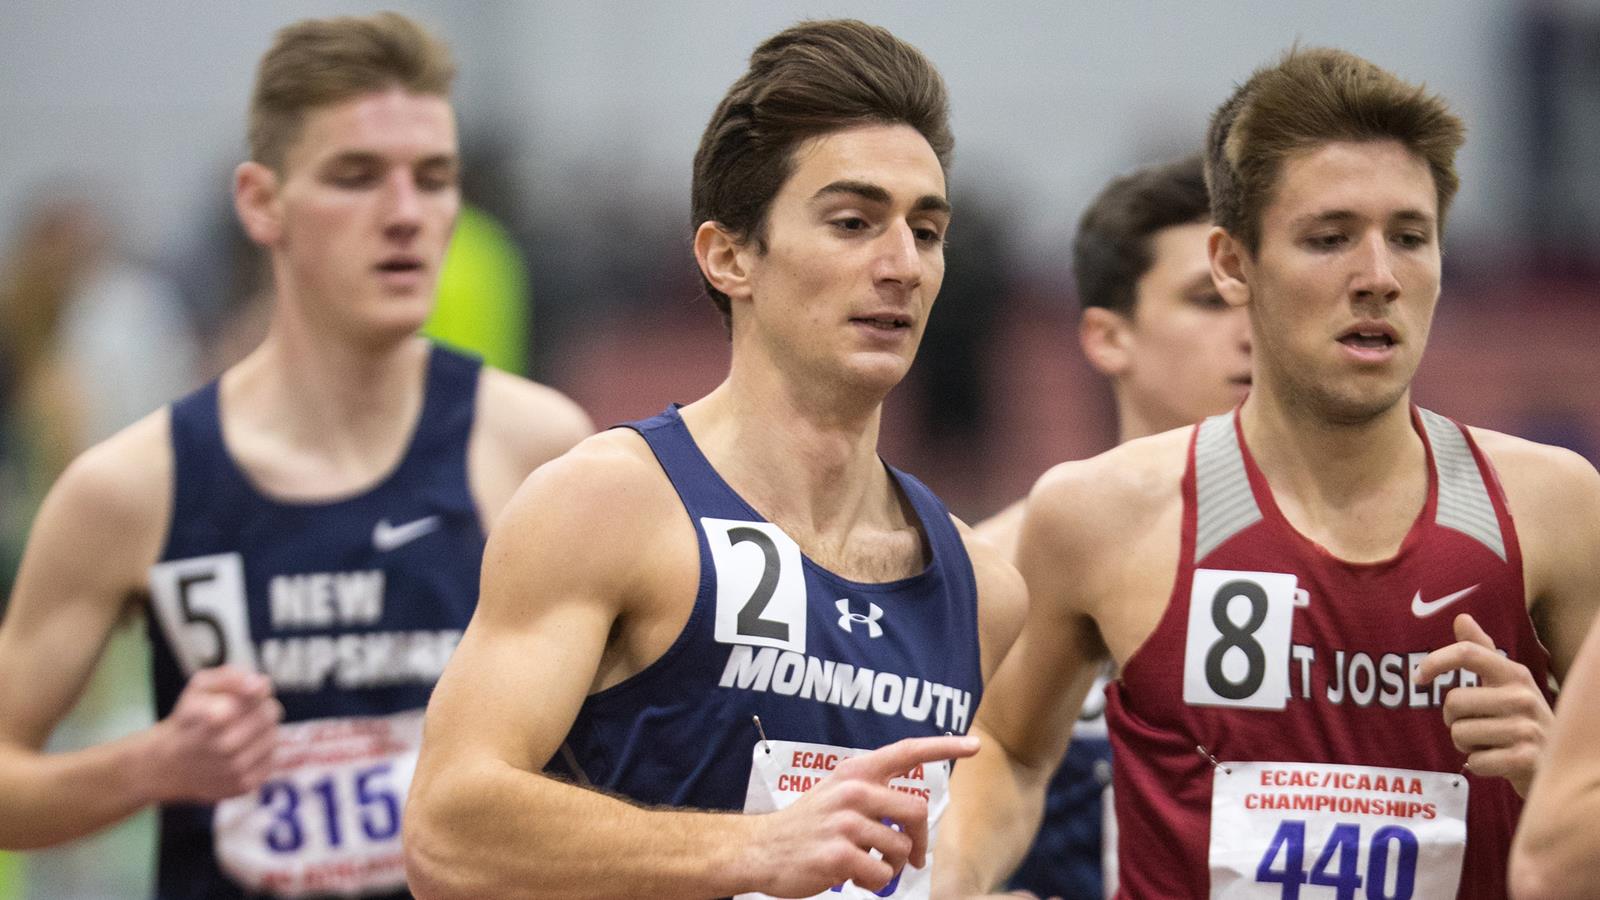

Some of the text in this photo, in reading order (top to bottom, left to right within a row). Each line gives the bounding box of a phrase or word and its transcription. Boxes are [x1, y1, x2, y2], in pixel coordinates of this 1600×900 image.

[177, 572, 227, 668] 5
[269, 570, 385, 630] NEW
[727, 527, 790, 642] 2
[1204, 579, 1269, 700] 8
[718, 645, 973, 735] MONMOUTH
[259, 763, 400, 854] 315
[1244, 793, 1437, 820] CHAMPIONSHIPS
[1260, 770, 1423, 794] ECAC/ICAAAA
[1255, 819, 1419, 900] 440
